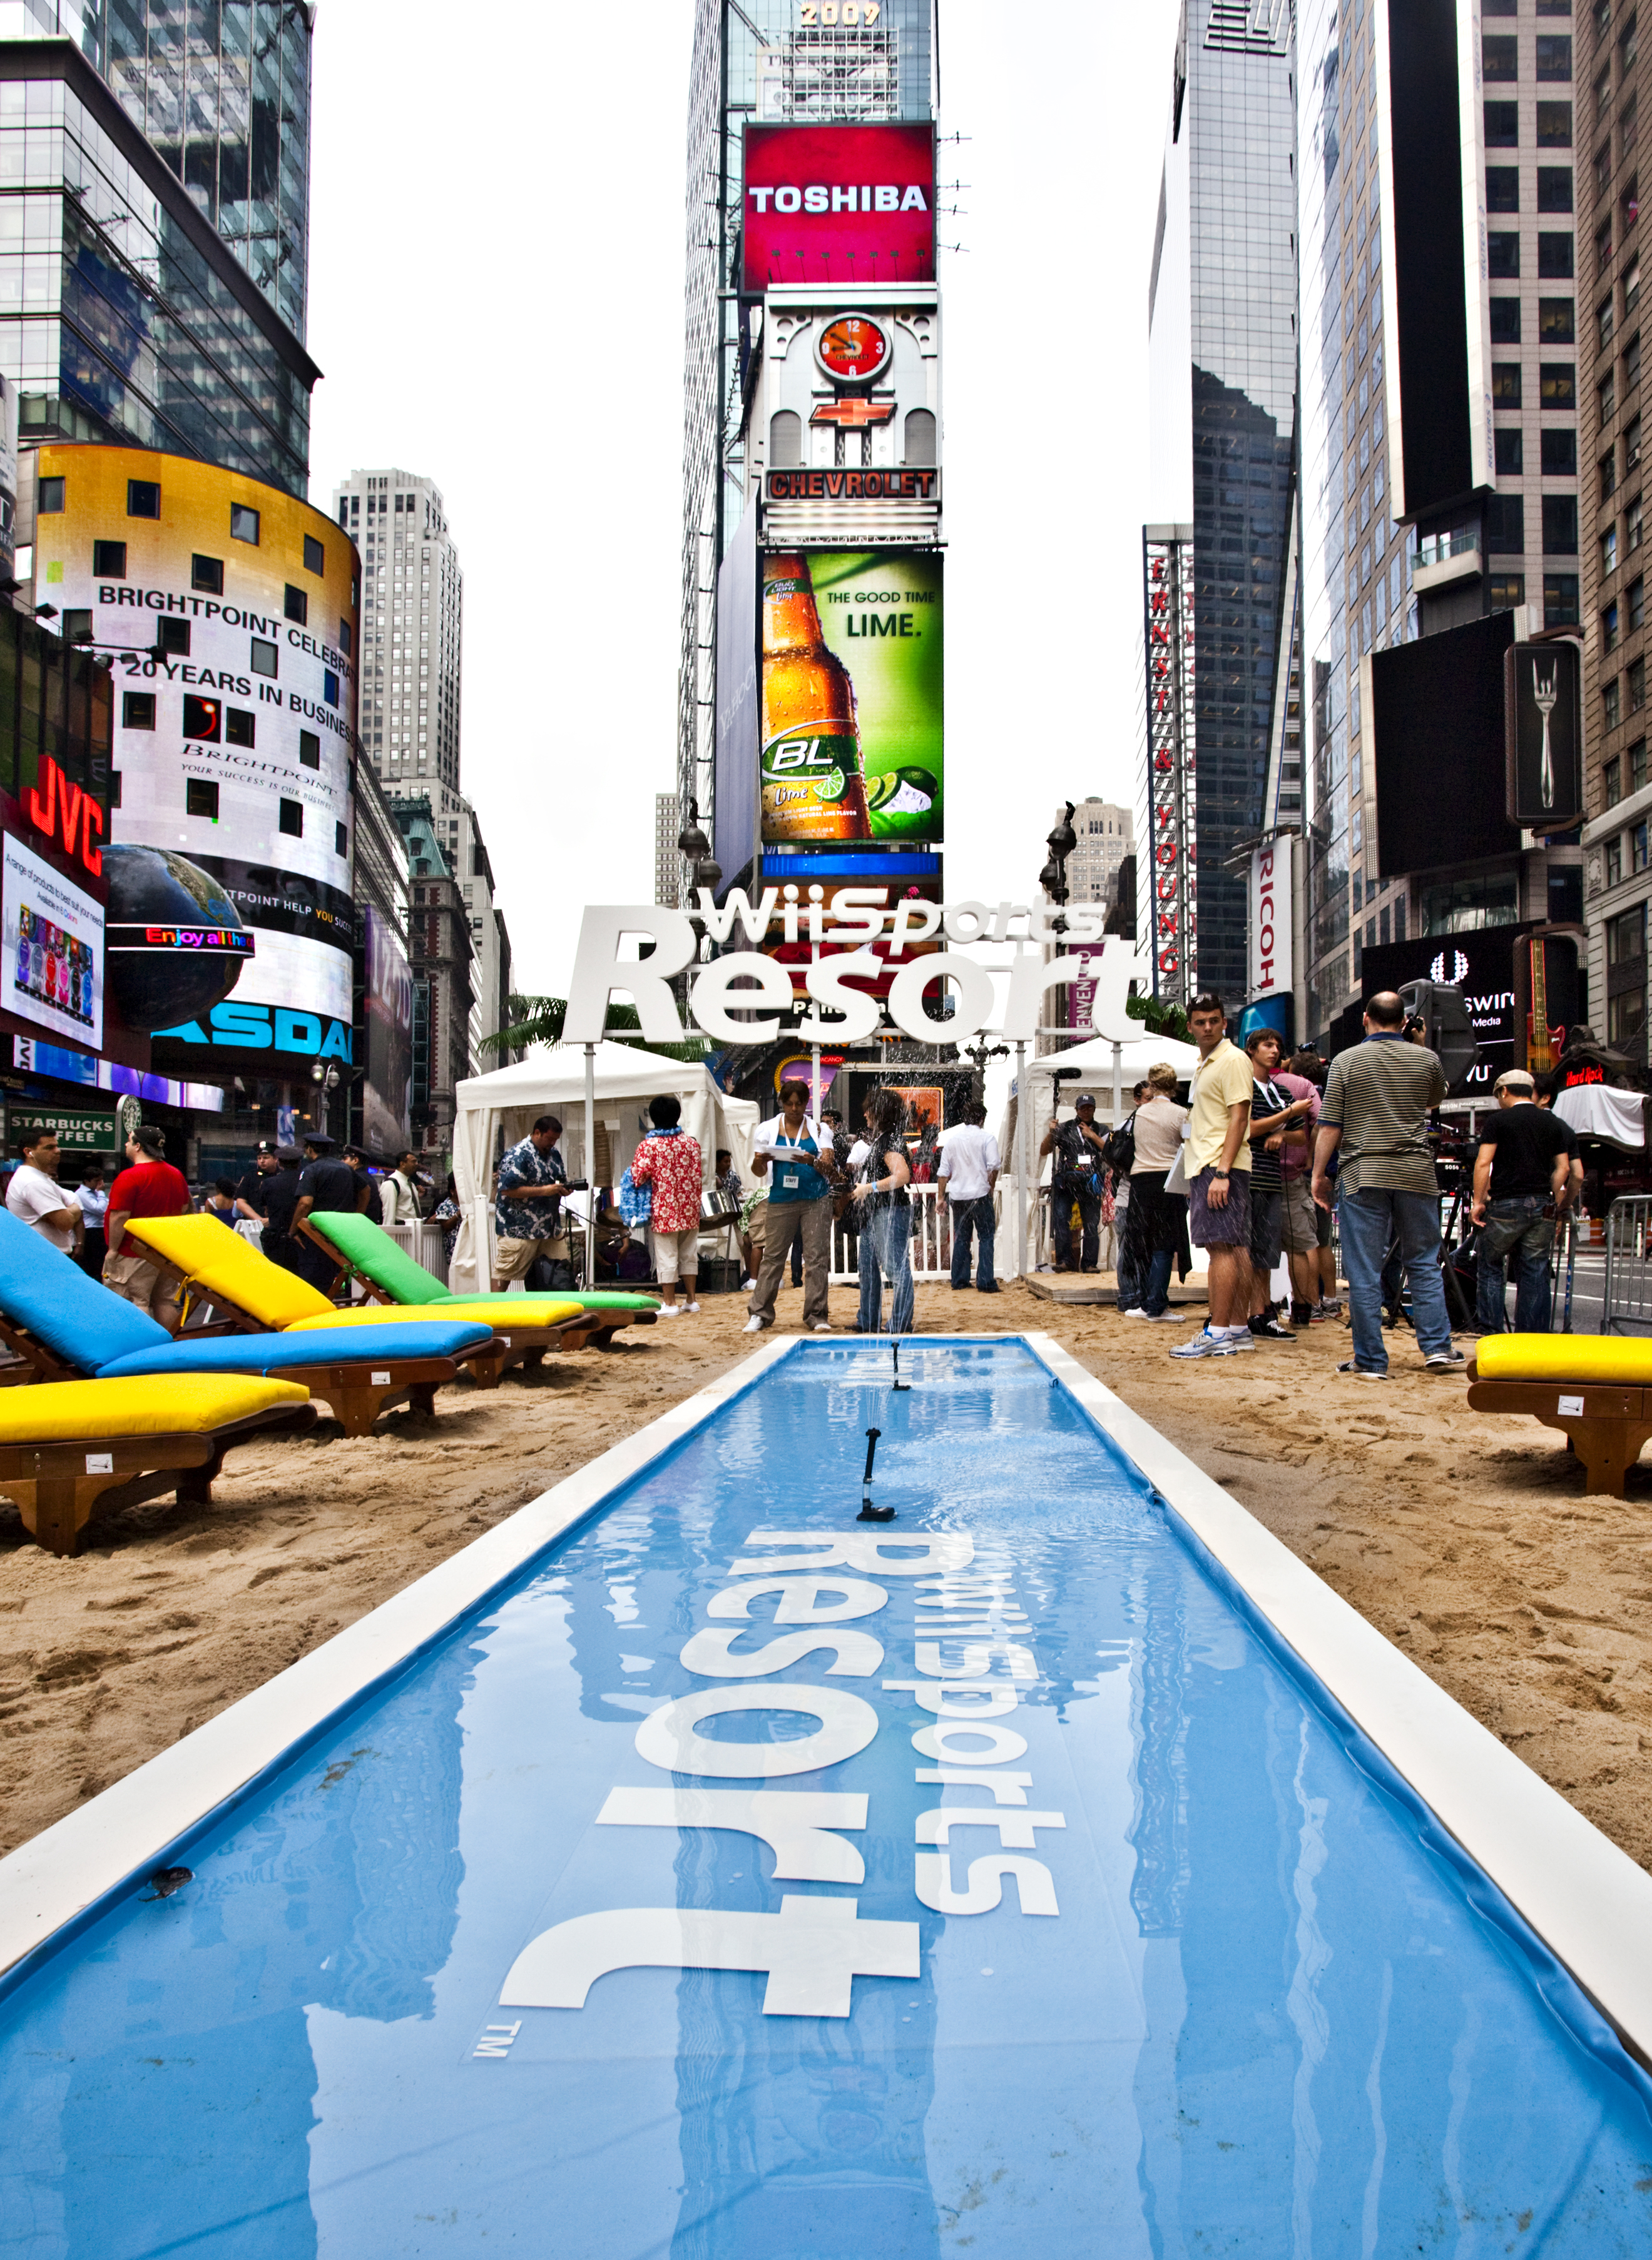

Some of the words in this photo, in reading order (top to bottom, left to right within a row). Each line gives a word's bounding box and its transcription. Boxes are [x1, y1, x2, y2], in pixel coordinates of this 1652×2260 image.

[800, 2, 880, 26] 2009
[748, 185, 927, 213] TOSHIBA
[846, 320, 860, 332] 12
[822, 342, 830, 355] 9
[875, 342, 884, 354] 3
[849, 365, 857, 376] 6
[770, 472, 934, 499] CHEVROLET
[771, 586, 797, 594] LIGHT
[827, 592, 850, 604] THE
[855, 591, 901, 604] GOOD
[904, 591, 936, 603] TIME
[99, 585, 282, 639] BRIGHTPOINT
[847, 613, 922, 638] LIME.
[1150, 557, 1171, 712] ERNST
[126, 659, 157, 678] 20
[163, 662, 252, 696] YEARS
[259, 683, 282, 707] IN
[290, 693, 355, 749] BUSINESS
[772, 739, 834, 771] BL
[1155, 748, 1174, 770] &
[180, 743, 337, 796] BRIGHTPOINT
[181, 763, 213, 775] YOUR
[218, 770, 265, 786] SUCCESS
[269, 781, 278, 790] IS
[282, 785, 300, 797] OUR
[303, 792, 336, 813] BUSINESS
[775, 786, 808, 807] Lime
[29, 754, 103, 877] JVC
[11, 858, 27, 875] range
[33, 873, 55, 895] products
[1156, 806, 1179, 972] YOUNG
[225, 889, 280, 907] TPOINT
[283, 900, 312, 915] HELP
[315, 909, 333, 924] YOU
[1259, 848, 1275, 990] RICOH
[145, 927, 205, 947] Enjoy
[207, 930, 225, 945] all
[227, 931, 246, 947] the
[562, 905, 1154, 1045] Resort
[1472, 1016, 1501, 1027] Media
[1566, 1069, 1585, 1087] Hard
[1584, 1064, 1604, 1086] Rock
[11, 1116, 114, 1133] STARBUCKS
[55, 1130, 96, 1143] FFEE
[499, 1530, 975, 2018] Resort
[472, 2020, 523, 2057] TM
